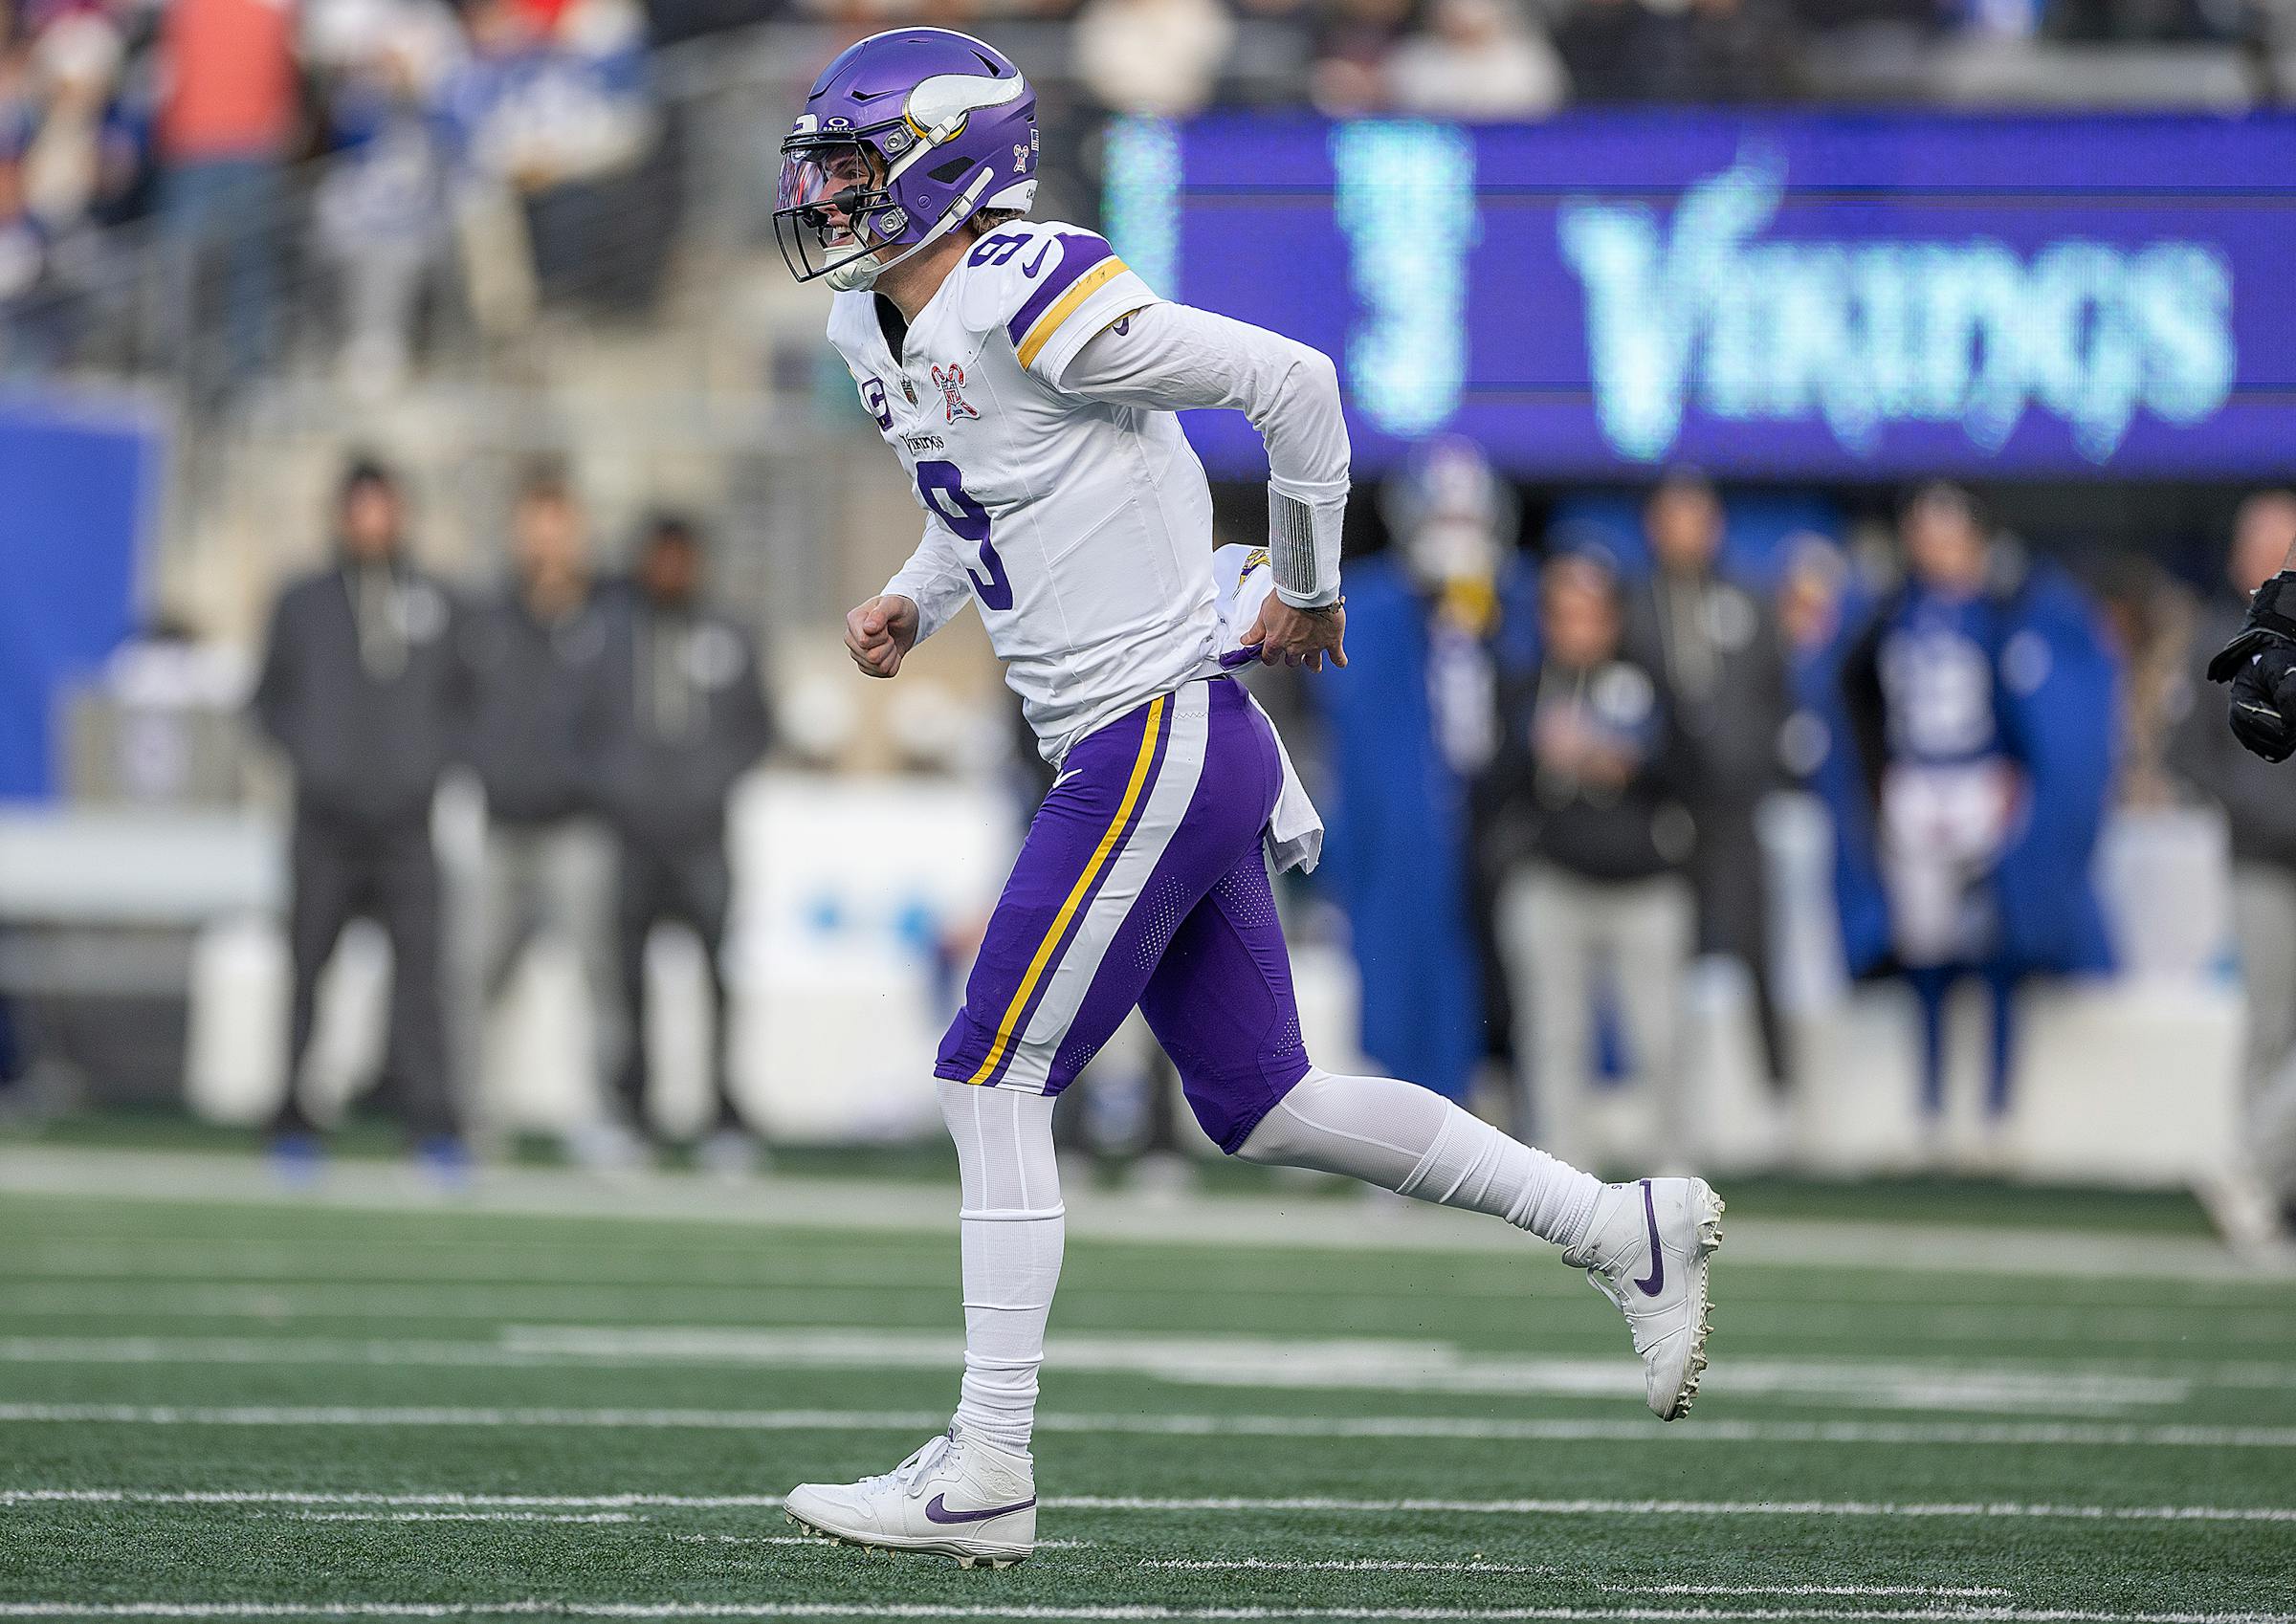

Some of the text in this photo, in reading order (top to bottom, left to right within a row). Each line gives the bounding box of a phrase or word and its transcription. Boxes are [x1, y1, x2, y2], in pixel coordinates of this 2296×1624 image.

[967, 233, 1034, 269] 9
[864, 381, 887, 419] C
[916, 460, 1014, 611] 9
